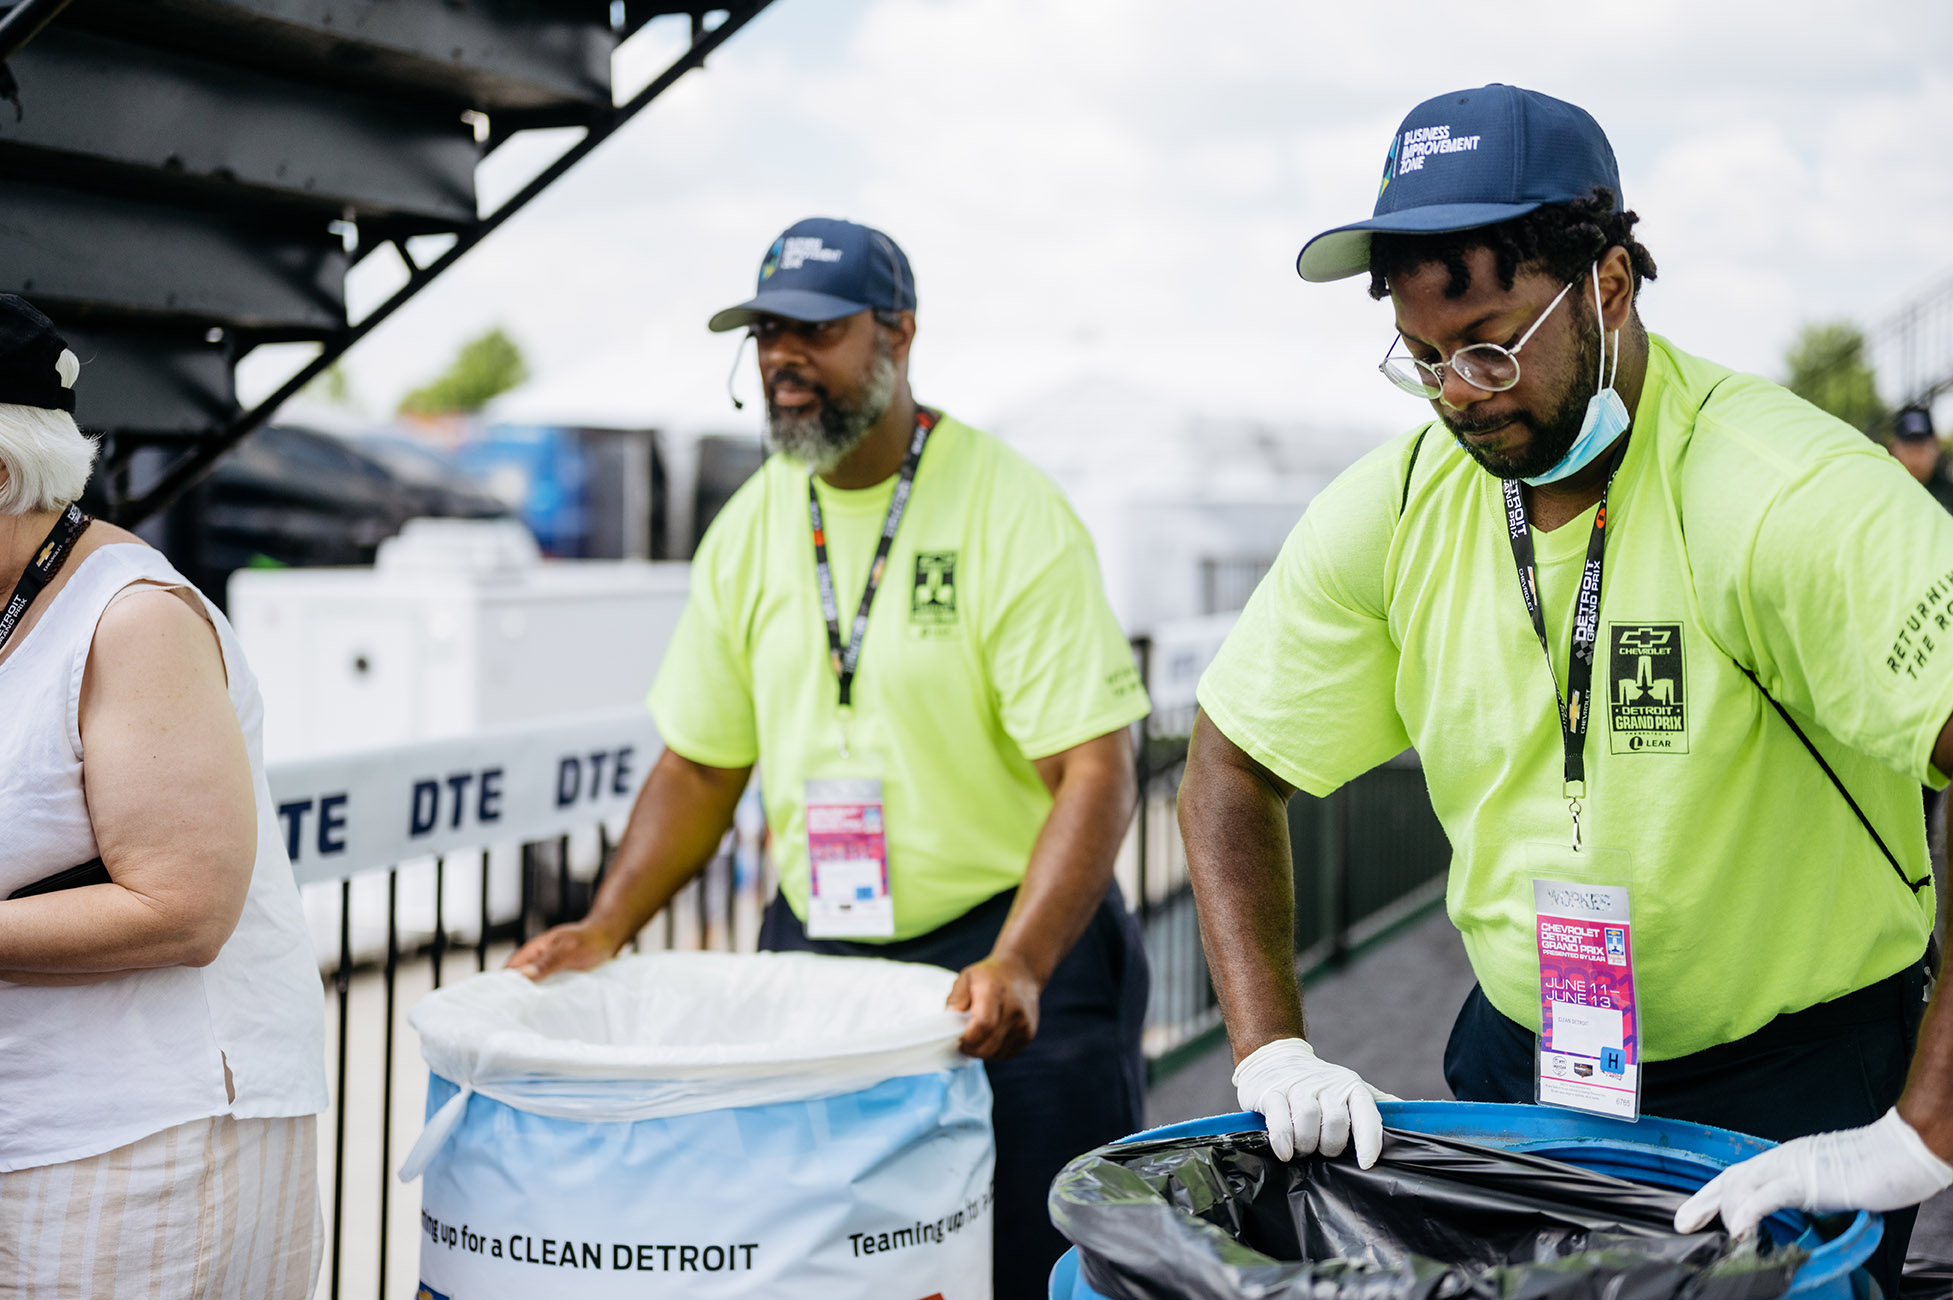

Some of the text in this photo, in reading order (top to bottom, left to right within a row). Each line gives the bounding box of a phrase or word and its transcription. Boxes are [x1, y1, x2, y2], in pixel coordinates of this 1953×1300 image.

[1404, 125, 1450, 146] BUSINESS
[1401, 135, 1480, 160] IMPROVEMENT
[1399, 155, 1425, 175] ZONE
[1503, 479, 1519, 539] AND PRIX
[1509, 479, 1527, 535] ETROIT
[1518, 568, 1534, 611] CHEVROLET
[13, 598, 28, 618] PRIX
[1576, 559, 1594, 641] DETROIT
[1587, 560, 1601, 642] GRAND PRIX
[0, 594, 21, 636] TROIT
[1619, 647, 1672, 655] CHEVROLET
[1906, 635, 1935, 681] THE
[1580, 689, 1591, 734] CHEVROLET
[1621, 706, 1673, 715] DETROIT
[1615, 715, 1682, 731] GRAND PRIX
[1646, 739, 1672, 748] LEAR
[278, 748, 634, 862] TE DTE DTE
[1541, 922, 1600, 938] CHEVROLET
[1541, 932, 1584, 945] DETROIT
[1541, 940, 1579, 953] GRAND
[1580, 945, 1605, 956] PRIX
[1588, 954, 1606, 962] LEAR
[1545, 977, 1586, 993] JUNE
[1546, 990, 1611, 1008] JUNE 13
[1608, 1053, 1618, 1069] H
[440, 1222, 457, 1249] up
[461, 1224, 487, 1254] for
[491, 1238, 503, 1258] a
[509, 1235, 601, 1270] CLEAN
[613, 1244, 758, 1271] DETROIT
[848, 1221, 944, 1257] Teaming
